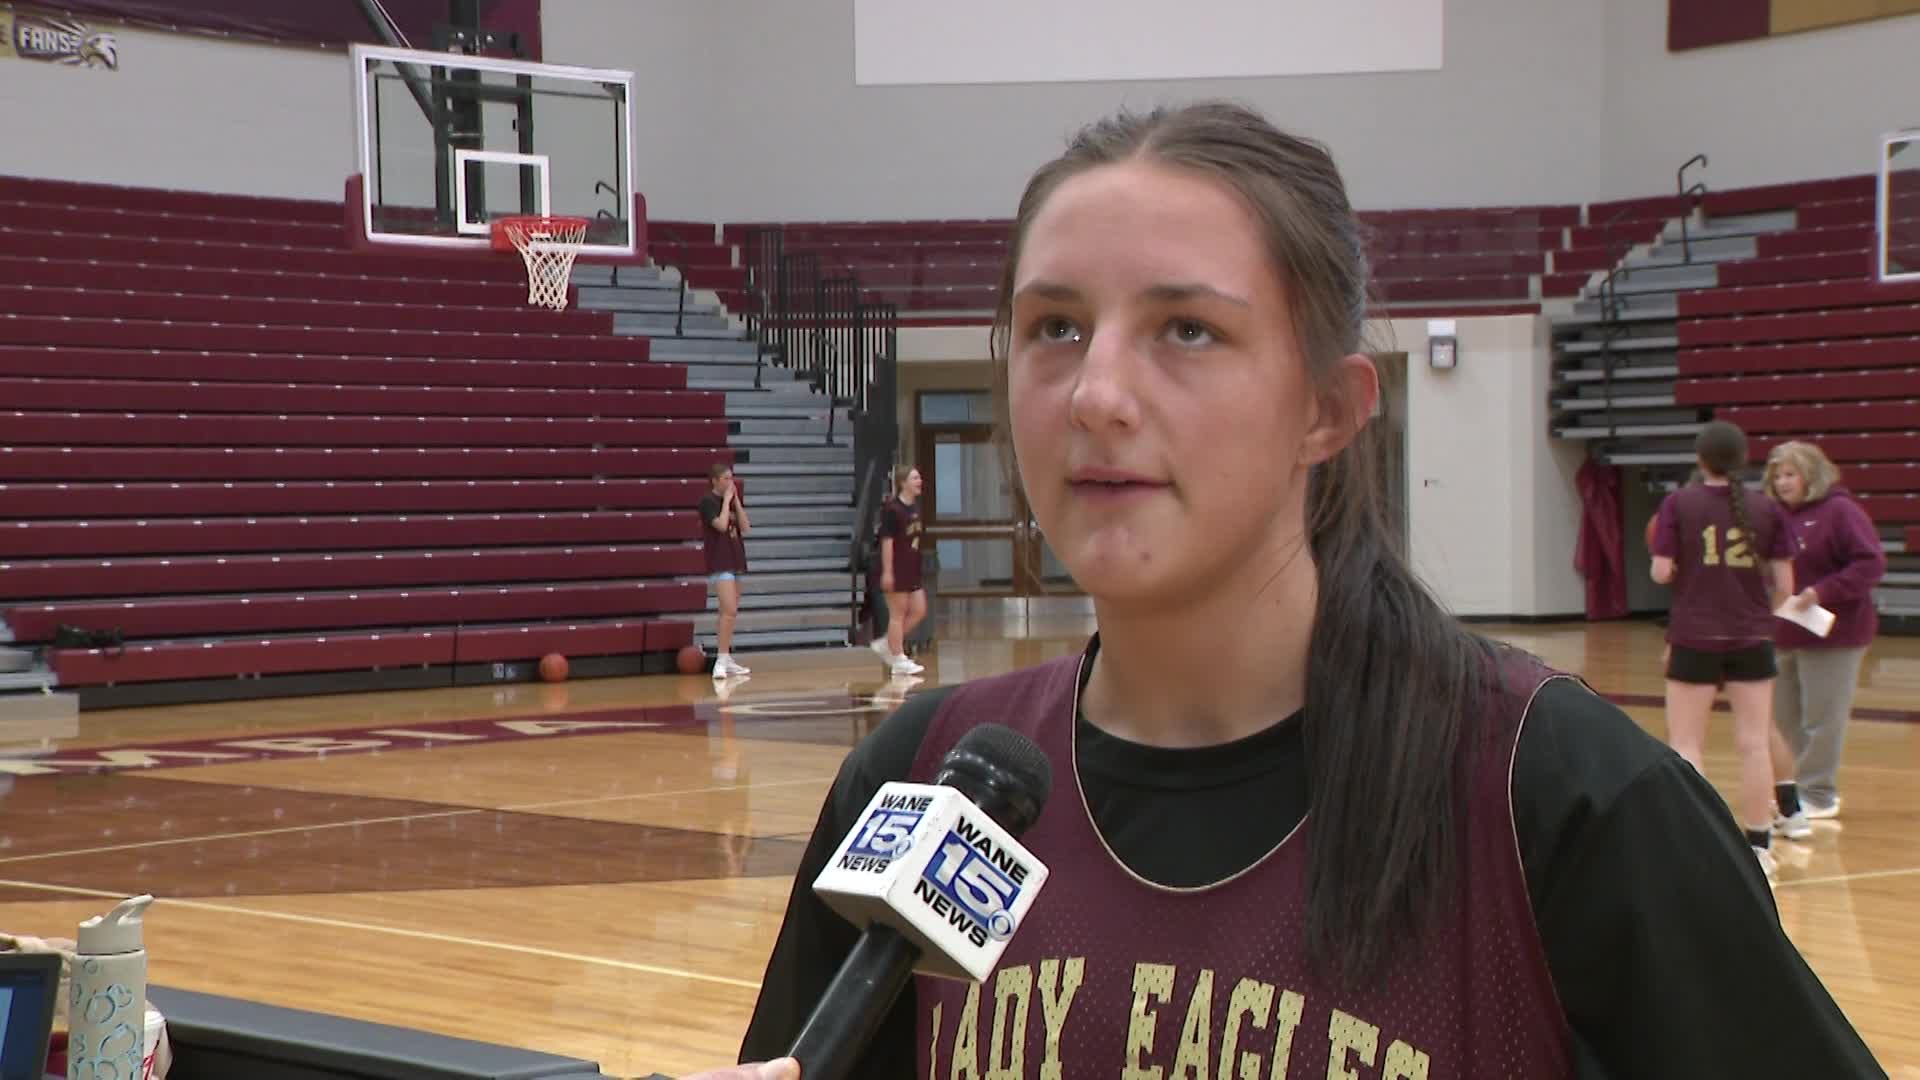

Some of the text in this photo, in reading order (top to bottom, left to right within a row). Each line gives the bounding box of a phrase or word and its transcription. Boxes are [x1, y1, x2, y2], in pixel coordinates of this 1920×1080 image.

[20, 26, 71, 53] FANS
[1702, 524, 1757, 567] 12
[880, 793, 934, 813] WANE
[855, 813, 918, 854] 15
[956, 815, 1030, 886] WANE
[836, 855, 892, 874] NEWS
[933, 840, 1015, 921] 15
[914, 879, 989, 949] NEWS
